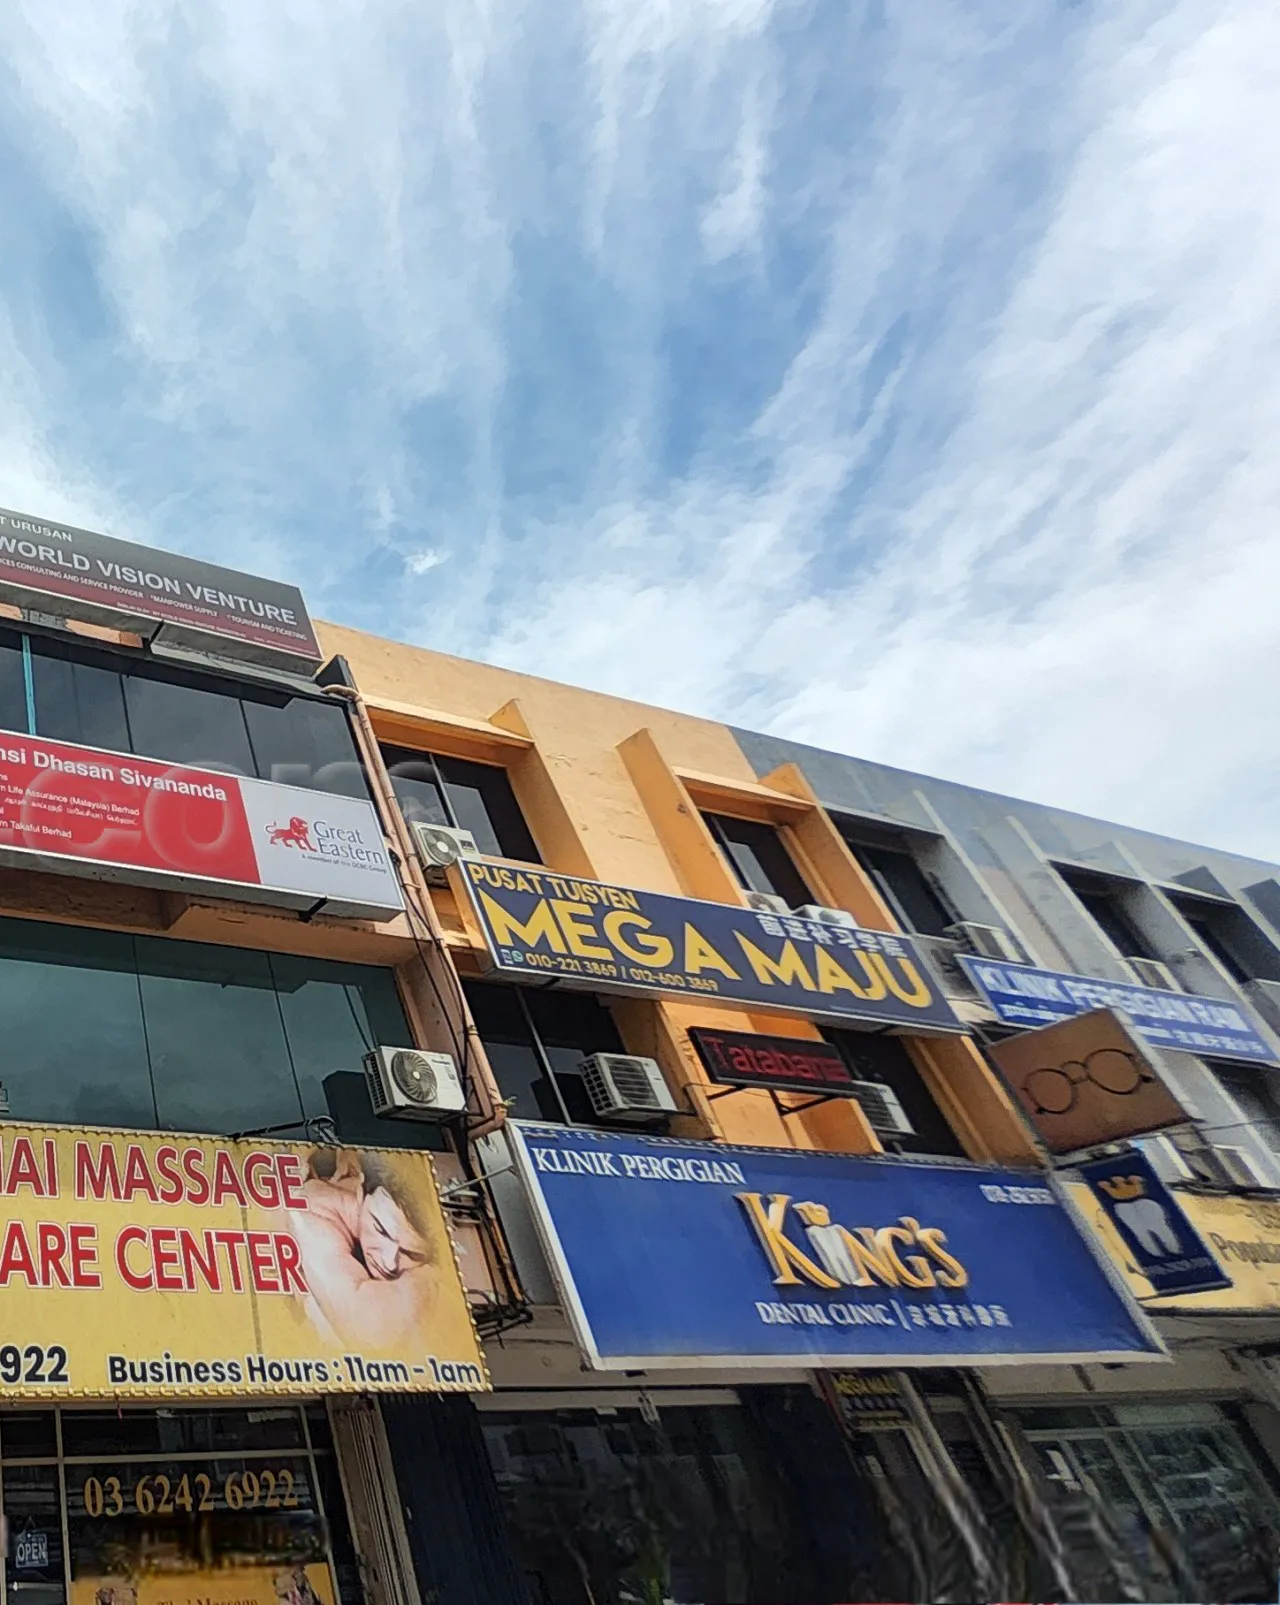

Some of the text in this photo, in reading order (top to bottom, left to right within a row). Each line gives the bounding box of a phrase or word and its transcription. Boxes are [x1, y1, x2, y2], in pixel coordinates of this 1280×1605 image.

[11, 519, 73, 542] URUSAN
[17, 561, 62, 579] CONSULTING
[63, 573, 80, 583] AND
[80, 577, 109, 590] SERVICE
[109, 584, 144, 598] PROVIDER
[97, 559, 181, 596] VISION
[185, 582, 299, 627] VENTURE
[33, 751, 115, 781] Dhasan
[120, 769, 227, 801] Sivananda
[8, 785, 23, 795] Life
[25, 789, 68, 804] Assurance
[69, 796, 110, 812] (Malaysia)
[112, 804, 140, 816] Berhad
[10, 820, 41, 833] Takaful
[42, 826, 73, 839] Berhad
[313, 820, 364, 845] Great
[317, 838, 385, 865] Eastern
[467, 863, 642, 911] PUSAT TUISYEN
[479, 887, 934, 1008] MEGA MAJU
[525, 952, 583, 973] 010-221
[584, 961, 618, 978] 3869
[75, 1140, 311, 1211] MASSAGE
[531, 1147, 747, 1185] KLINIK PERGIGIAN
[115, 1225, 311, 1295] CENTER
[754, 1302, 834, 1326] DENTAL
[827, 1303, 897, 1327] CLINIC
[107, 1352, 242, 1386] Business
[344, 1355, 410, 1385] 11am
[428, 1356, 482, 1385] 1am
[83, 1469, 299, 1518] 03 6242 6922
[17, 1542, 48, 1562] OPEN
